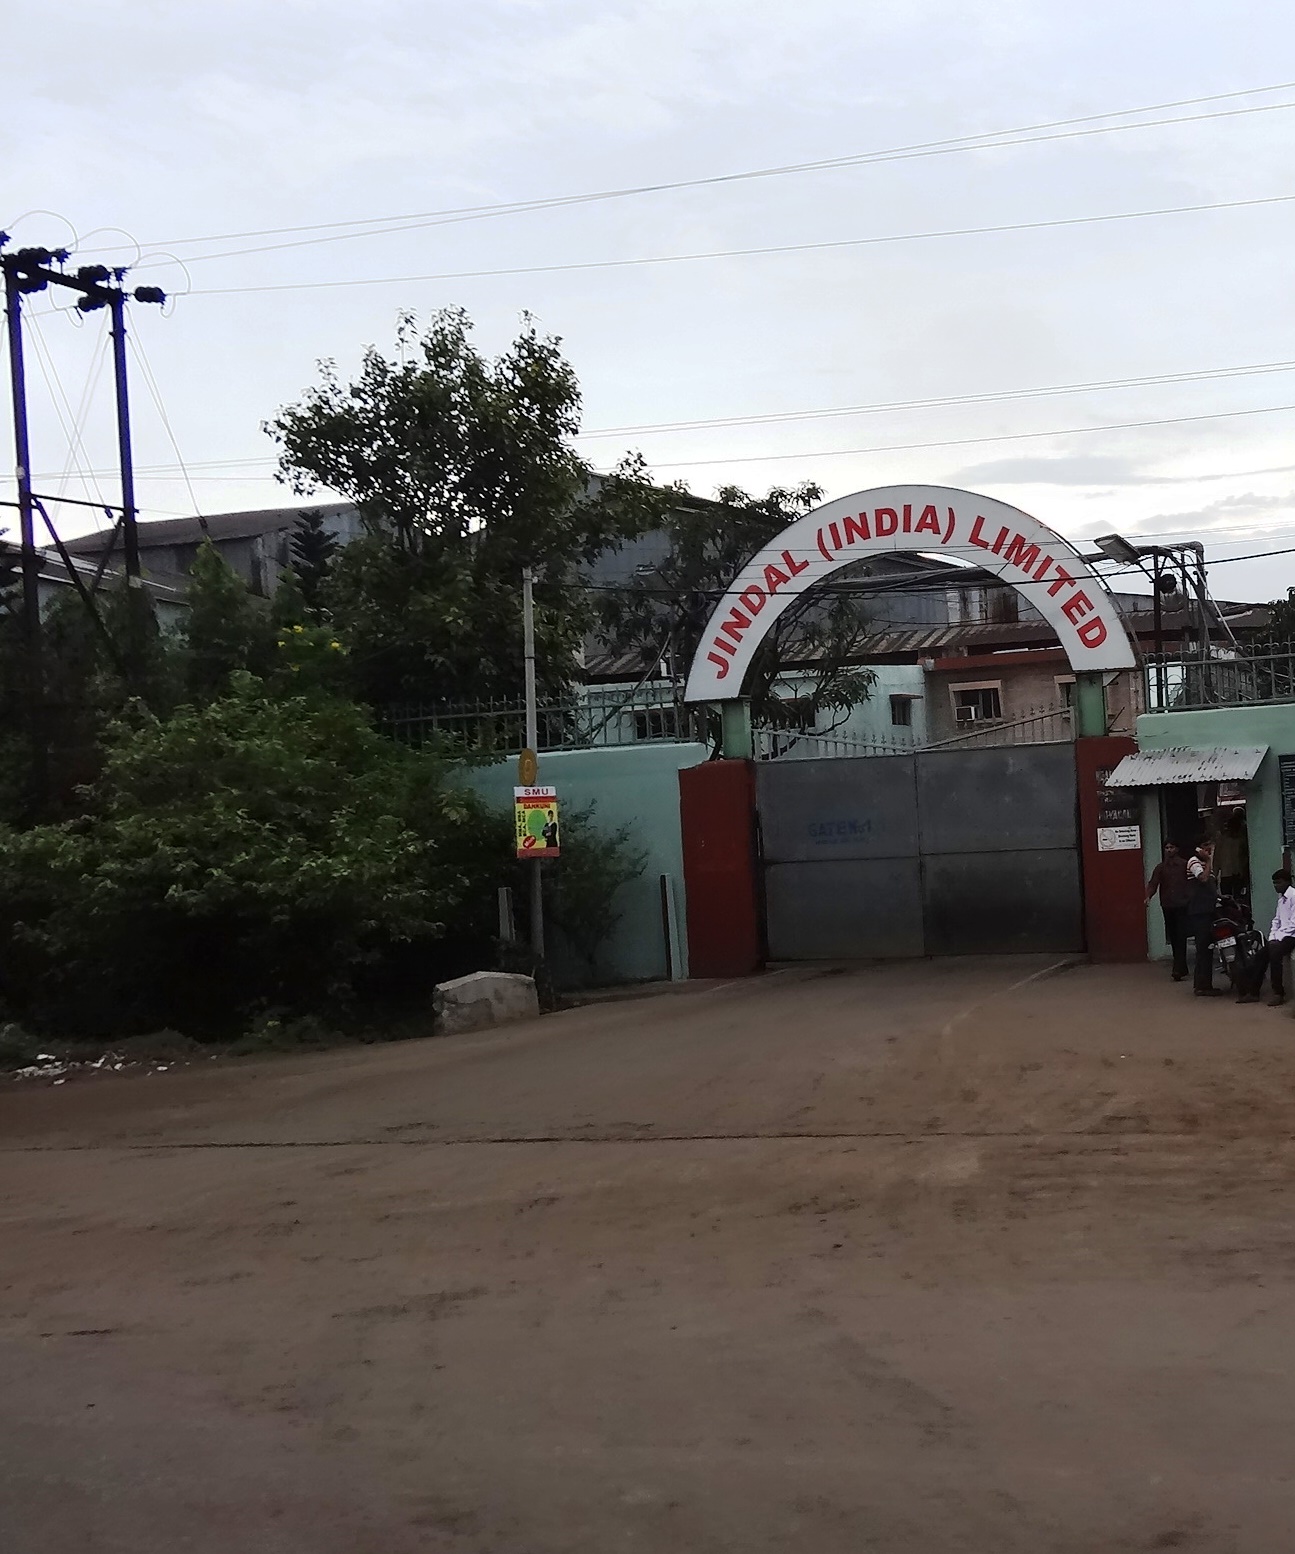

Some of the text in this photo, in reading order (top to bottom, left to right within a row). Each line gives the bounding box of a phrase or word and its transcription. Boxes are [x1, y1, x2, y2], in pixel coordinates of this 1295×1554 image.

[706, 504, 1108, 680] JINDAL (INDIA) LIMITED
[524, 788, 549, 796] SMU
[808, 821, 847, 838] GATE
